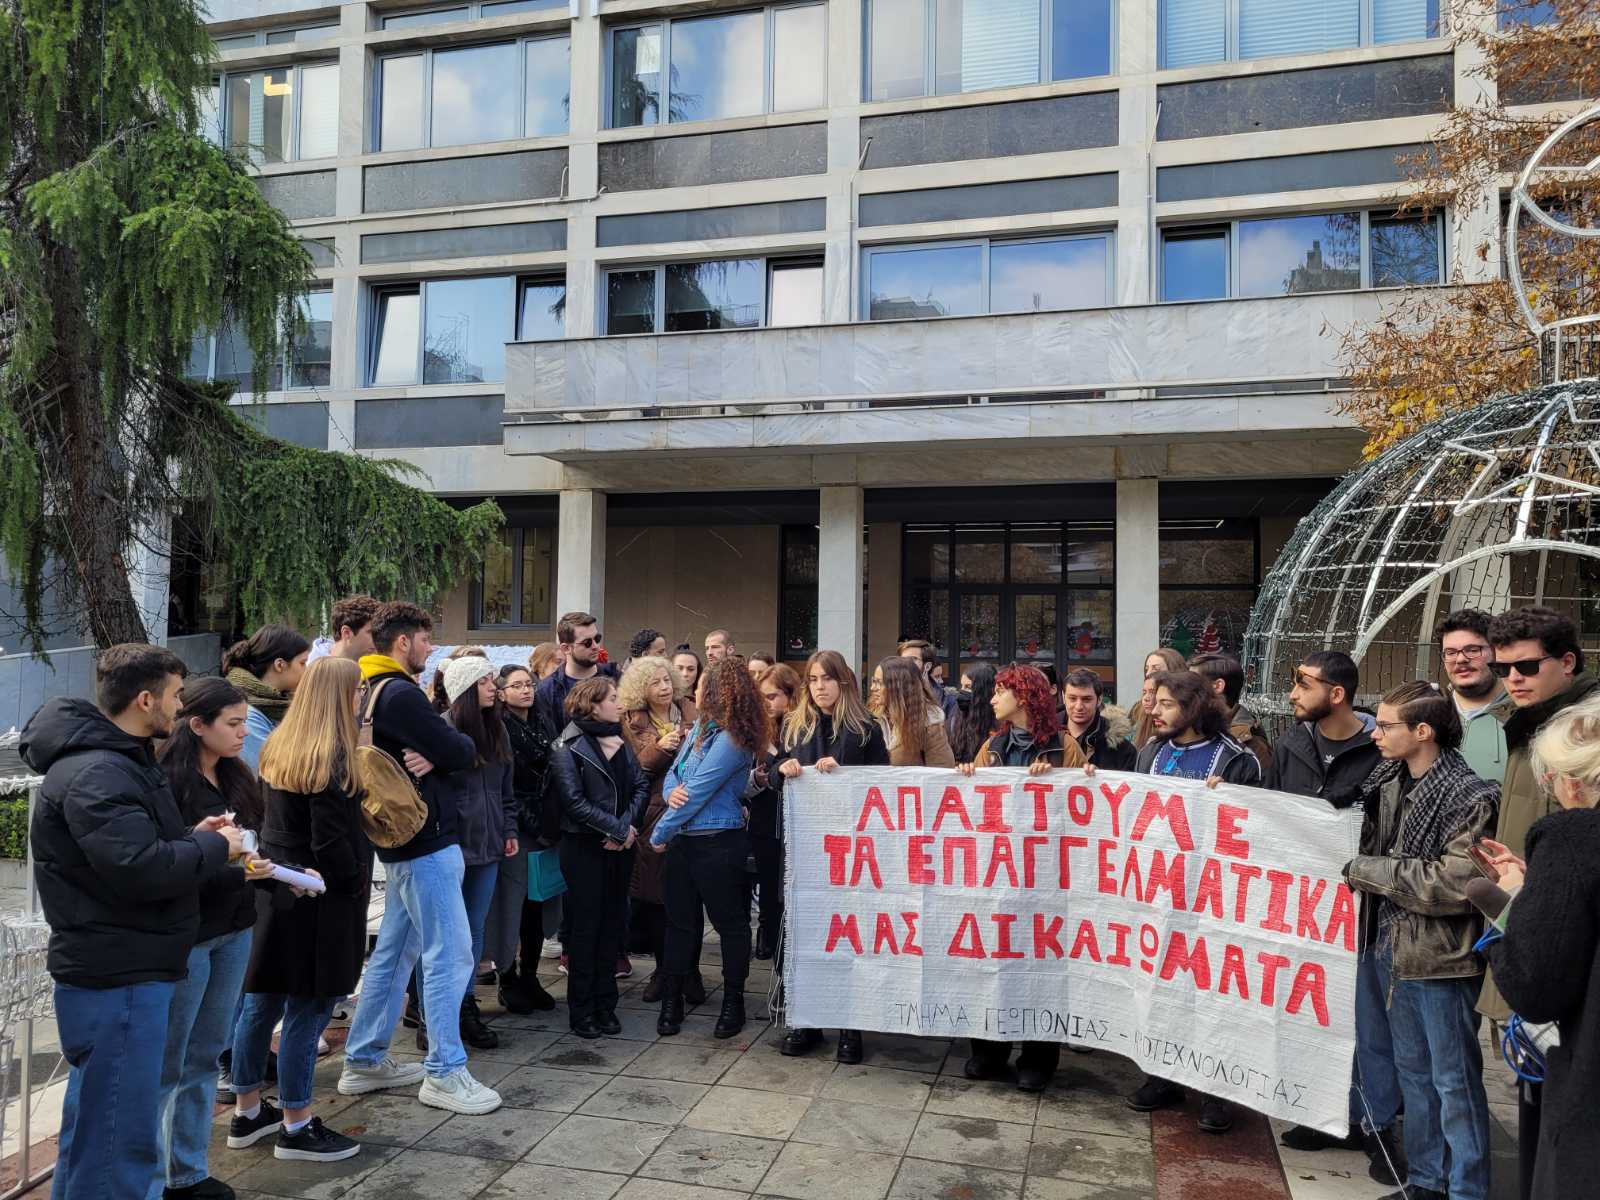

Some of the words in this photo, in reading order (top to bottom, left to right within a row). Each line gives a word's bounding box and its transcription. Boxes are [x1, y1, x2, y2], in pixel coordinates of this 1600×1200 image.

[856, 782, 1250, 860] ΑΠΑΙΤΟΥΜΕ
[823, 834, 883, 889] ΤΑ
[907, 835, 1357, 952] ΕΠΑΓΓΕΛΜΑΤΙΚΑ
[825, 911, 924, 956] ΜΑΣ
[947, 912, 1330, 1027] ΔΙΚΑΙΩΜΑΤΑ
[895, 1002, 971, 1030] ΤΜΗΜΑ
[984, 1006, 1113, 1043] ΓΕΩΠΟΝΙΑΣ
